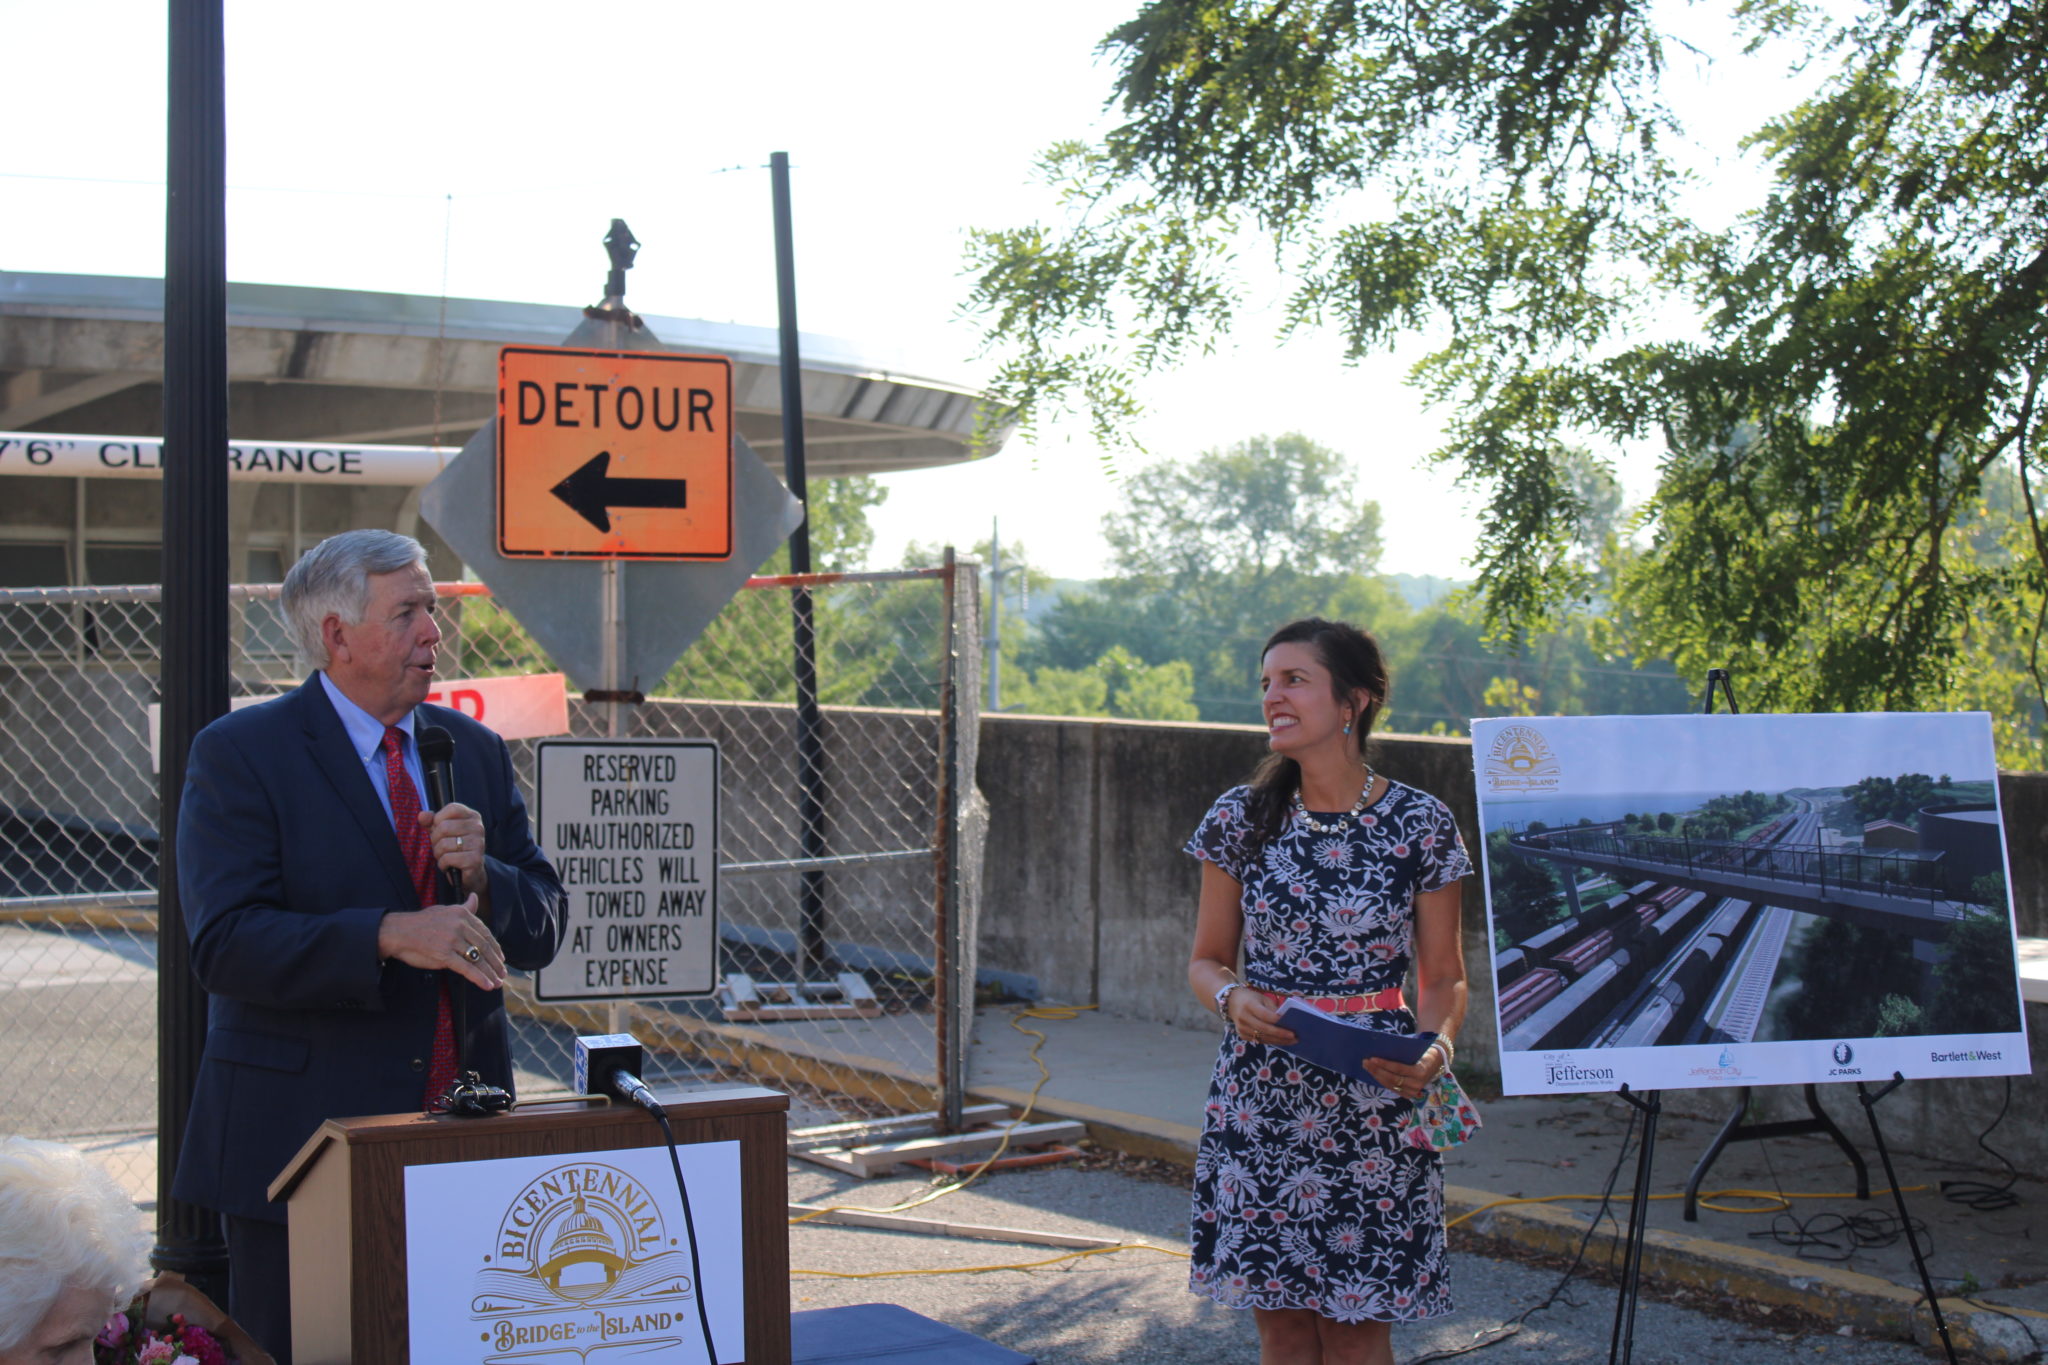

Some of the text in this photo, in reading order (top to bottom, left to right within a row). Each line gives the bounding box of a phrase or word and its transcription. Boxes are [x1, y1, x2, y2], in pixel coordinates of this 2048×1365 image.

[518, 380, 714, 432] DETOUR
[98, 442, 363, 475] CLRANCE
[1493, 727, 1549, 757] BICENTENNIAL
[584, 754, 676, 783] RESERVED
[591, 789, 669, 816] PARKING
[557, 822, 694, 850] UNAUTHORIZED
[556, 856, 700, 885] VEHICLES WILL
[585, 890, 646, 919] TOWED
[657, 889, 707, 917] AWAY
[572, 924, 682, 954] AT OWNERS
[586, 958, 669, 987] EXPENSE
[1931, 1050, 2002, 1063] Bartlett&West
[1547, 1065, 1614, 1085] Jefferson
[1838, 1068, 1862, 1076] PARKS
[501, 1168, 661, 1260] BICENTENNIAL
[493, 1311, 672, 1352] BRIDGE to the ISLAND
